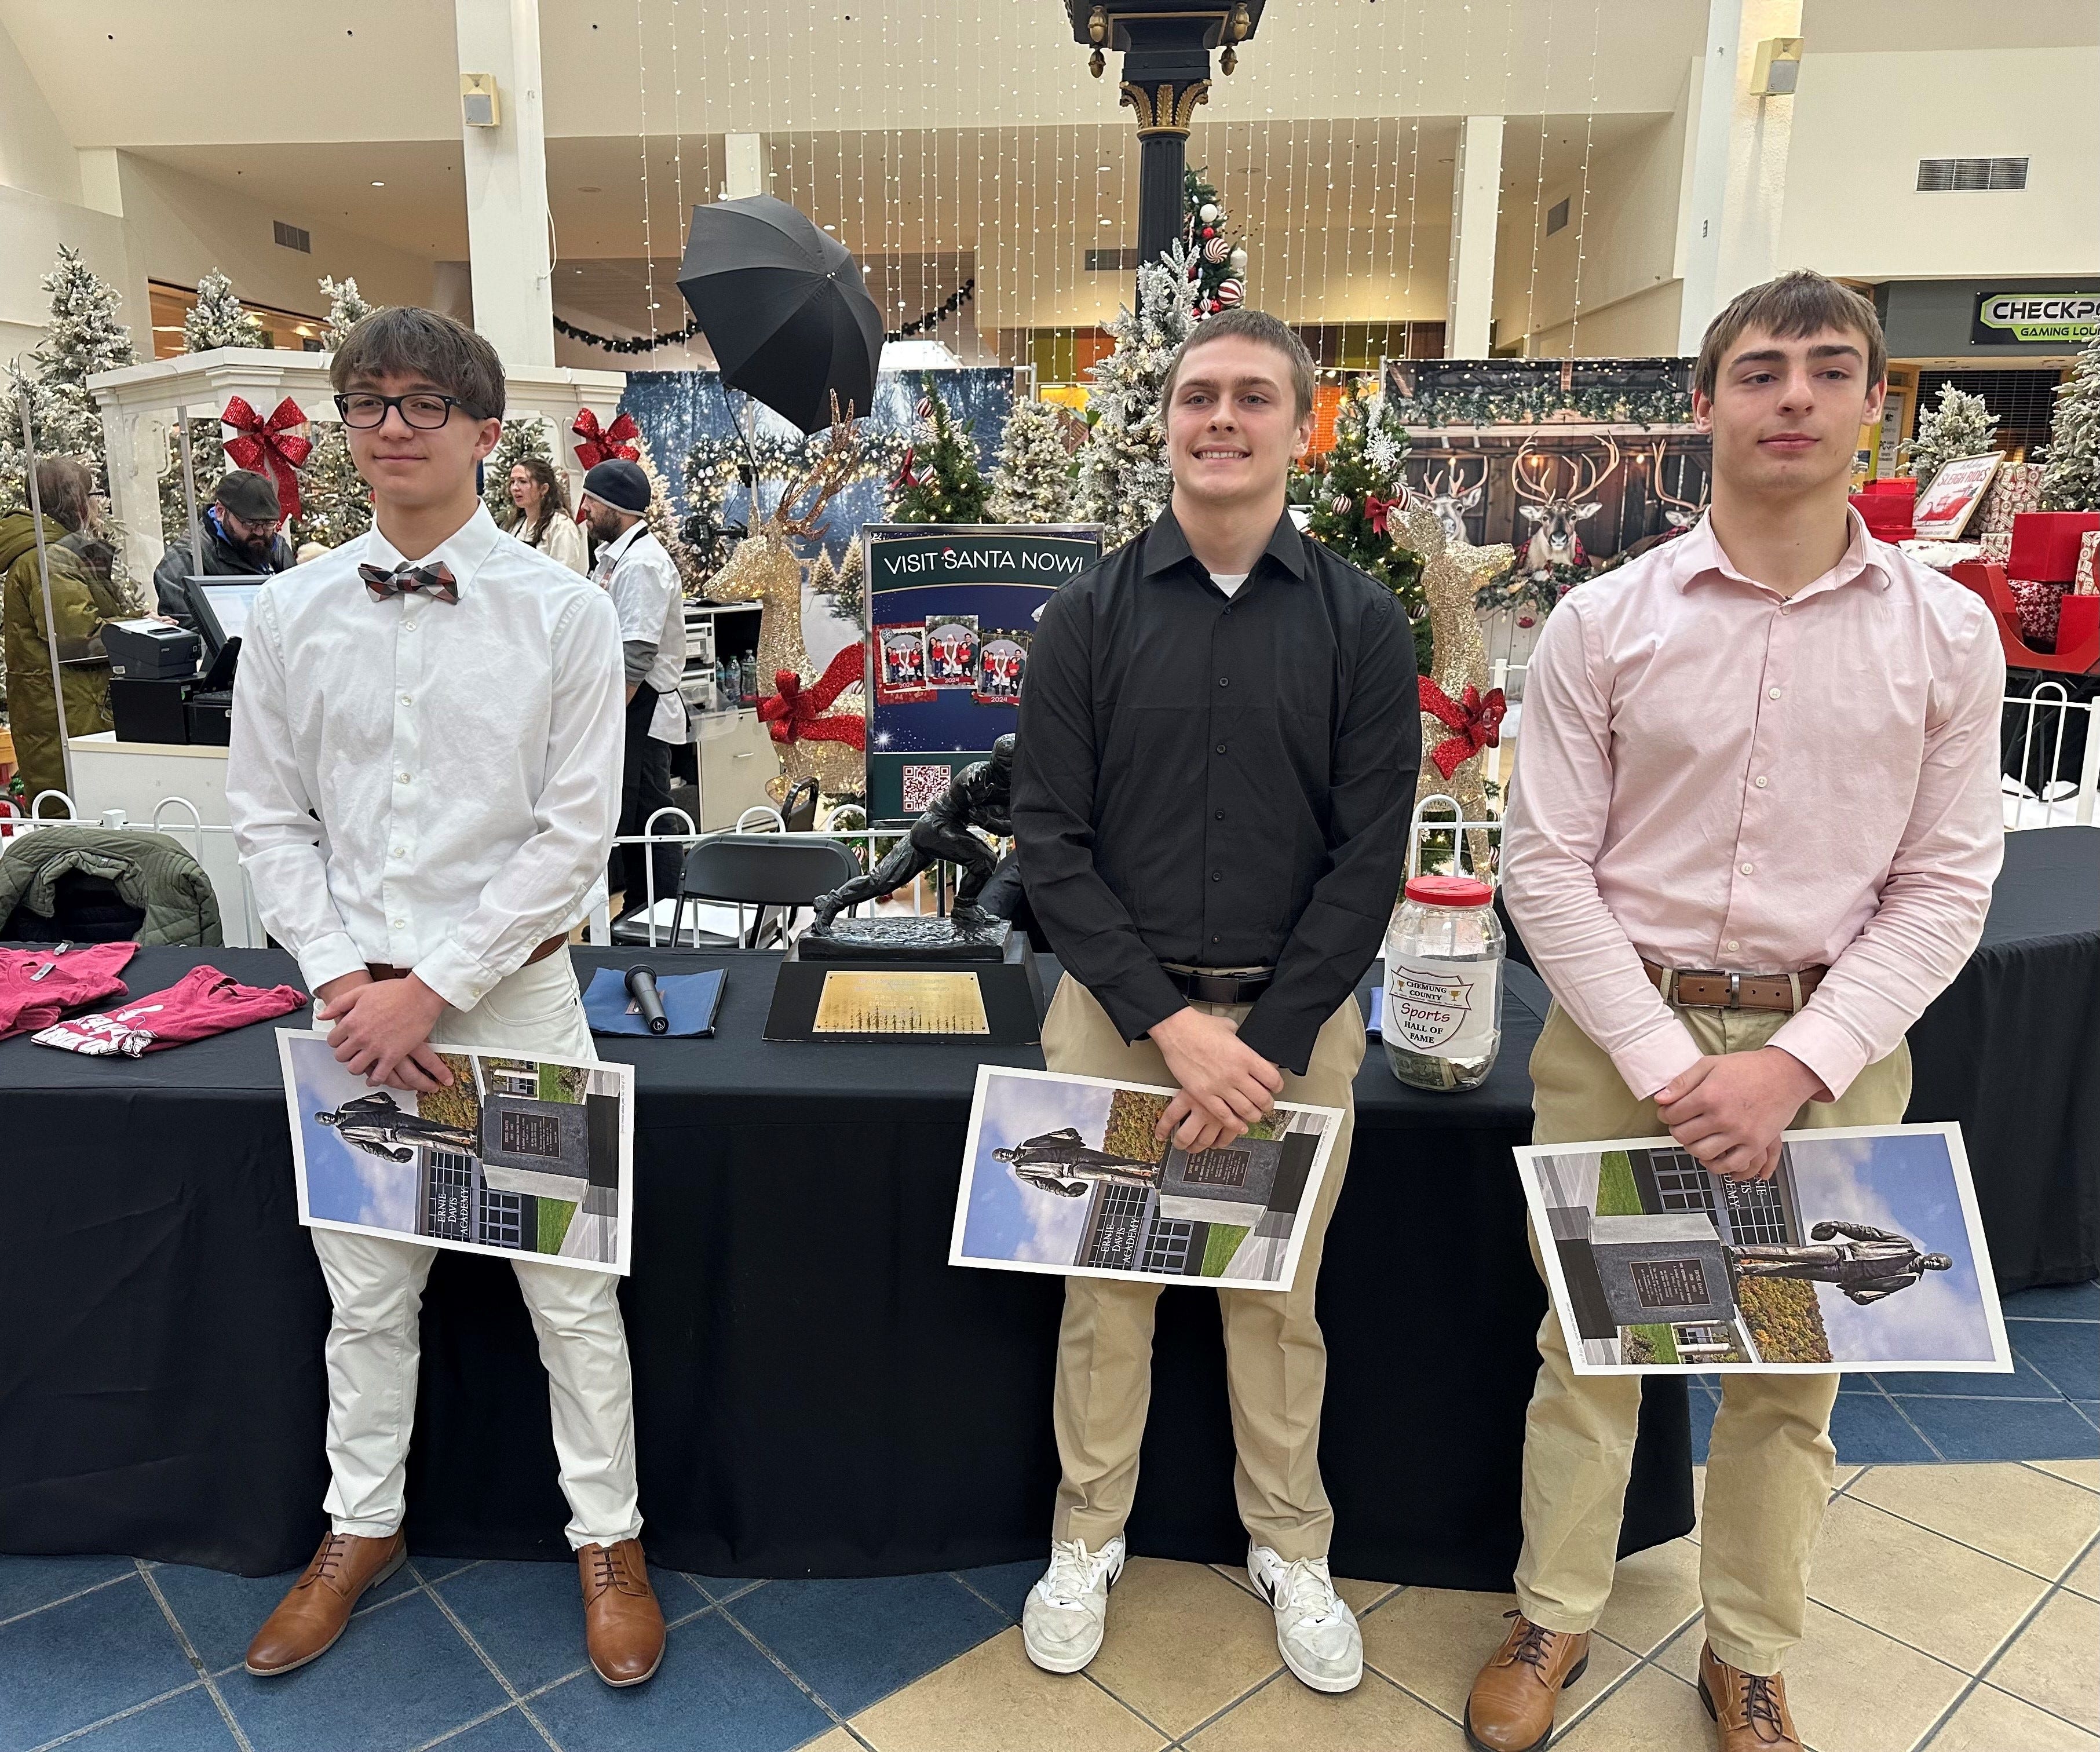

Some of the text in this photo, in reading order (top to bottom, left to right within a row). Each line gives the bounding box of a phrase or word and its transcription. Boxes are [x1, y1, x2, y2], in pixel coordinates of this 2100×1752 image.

[1993, 301, 2100, 319] CHECKP
[2021, 327, 2100, 336] GAMING LOU
[1937, 467, 1991, 487] SLEIGH RIDES
[884, 552, 938, 575] VISIT
[944, 550, 1016, 570] SANTA
[1407, 981, 1447, 994] CHEMUNG
[1409, 990, 1442, 1001] COUNTY
[1401, 1002, 1450, 1023] Sports
[1404, 1020, 1444, 1035] HALL OF
[1409, 1032, 1435, 1043] FAME
[1723, 1174, 1740, 1207] DEMY
[437, 1192, 447, 1223] ERNIE
[447, 1196, 458, 1222] DAVIS
[459, 1187, 469, 1235] ACADEMY
[1100, 1222, 1115, 1254] ERNIE
[1112, 1226, 1126, 1253] DAVIS
[1123, 1216, 1139, 1264] ACADEMY
